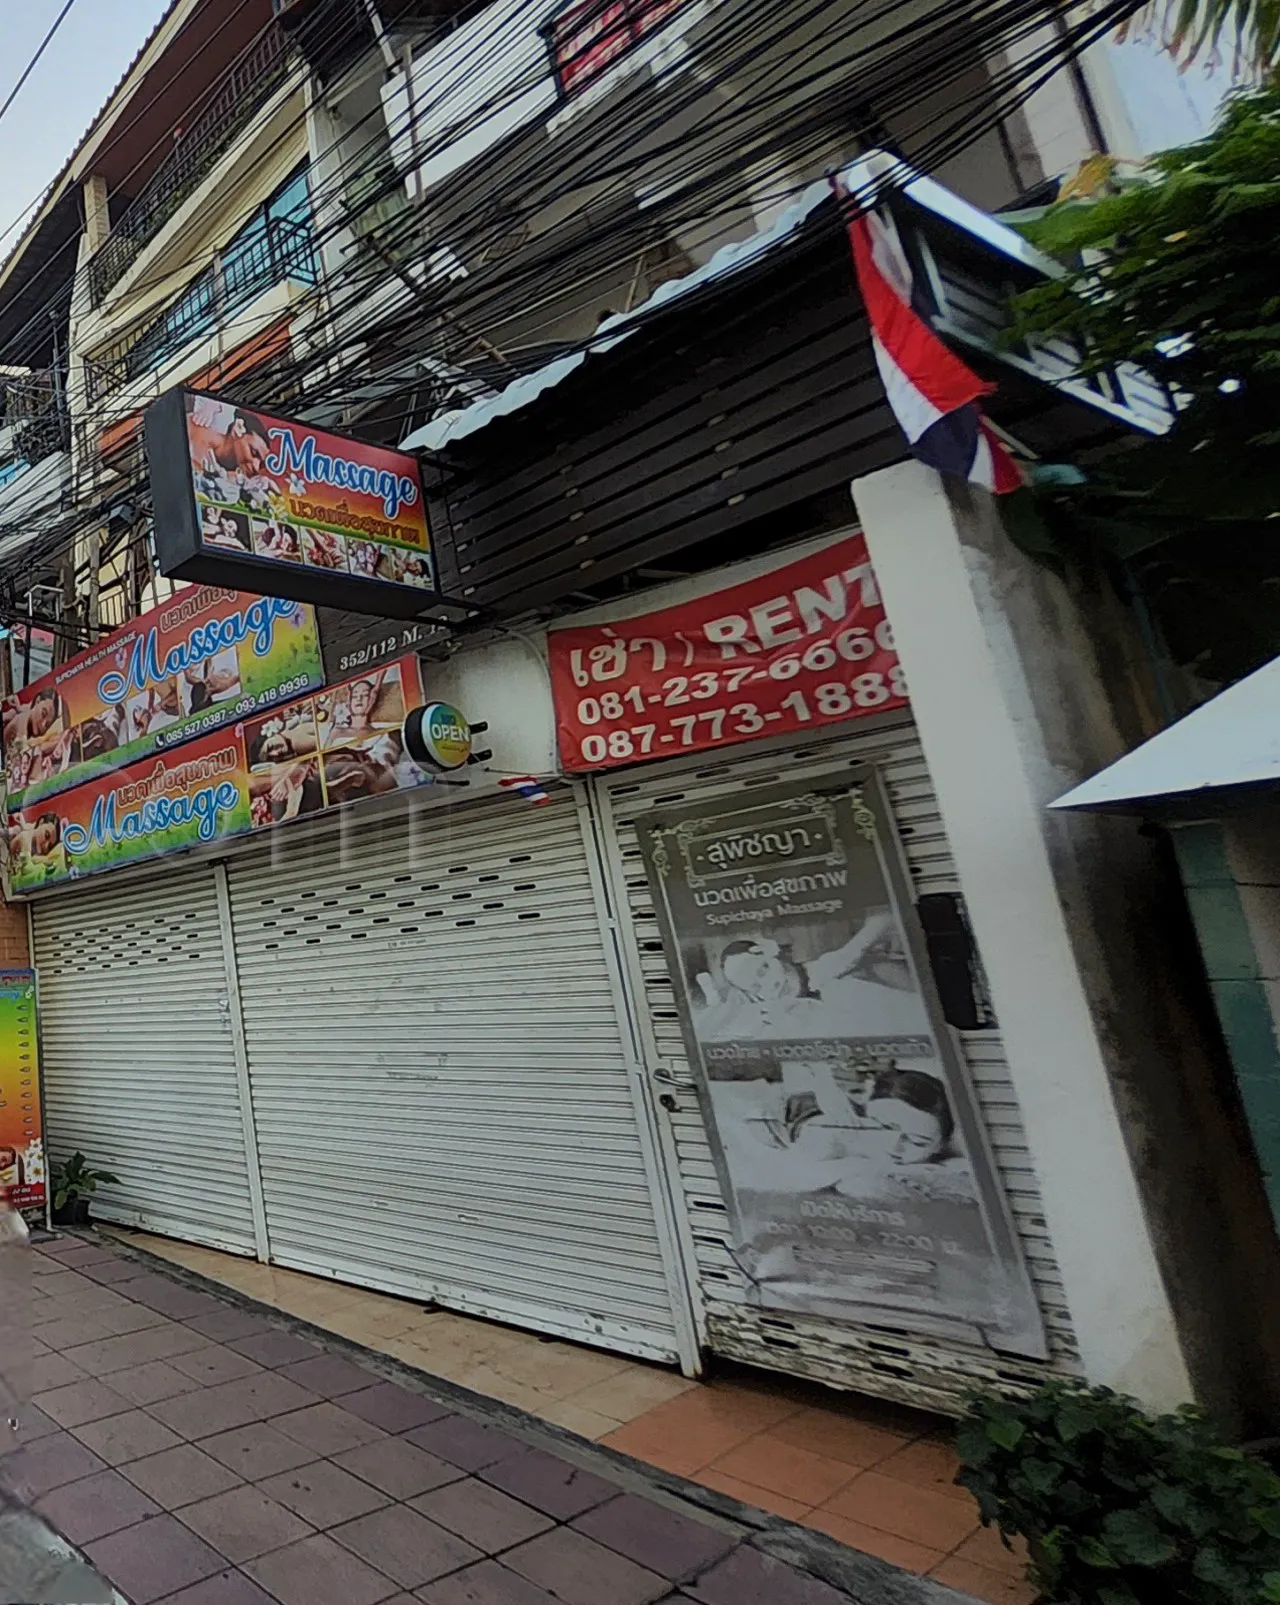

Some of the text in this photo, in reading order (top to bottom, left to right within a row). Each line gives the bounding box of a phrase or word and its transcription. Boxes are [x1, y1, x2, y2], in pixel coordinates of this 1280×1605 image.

[266, 428, 418, 519] Massage
[84, 648, 106, 668] HEALTH
[107, 630, 137, 654] MASSAGE
[97, 596, 298, 704] Massage
[339, 637, 397, 671] 352/112
[401, 625, 423, 647] M.
[570, 628, 667, 688] เช่า
[703, 562, 881, 660] RENT
[166, 729, 183, 744] 085
[184, 720, 201, 736] 527
[202, 711, 226, 728] 0387
[235, 698, 256, 715] 093
[258, 687, 277, 704] 418
[278, 674, 309, 696] 9936
[431, 723, 469, 742] OPEN
[116, 746, 237, 809] นวดเพื่อสุขภาพ
[63, 780, 240, 855] Massage
[706, 828, 811, 869] สุพิชญา
[694, 870, 849, 907] นวดเพื่อสุขภาพ
[705, 899, 844, 926] Supichaya Massage
